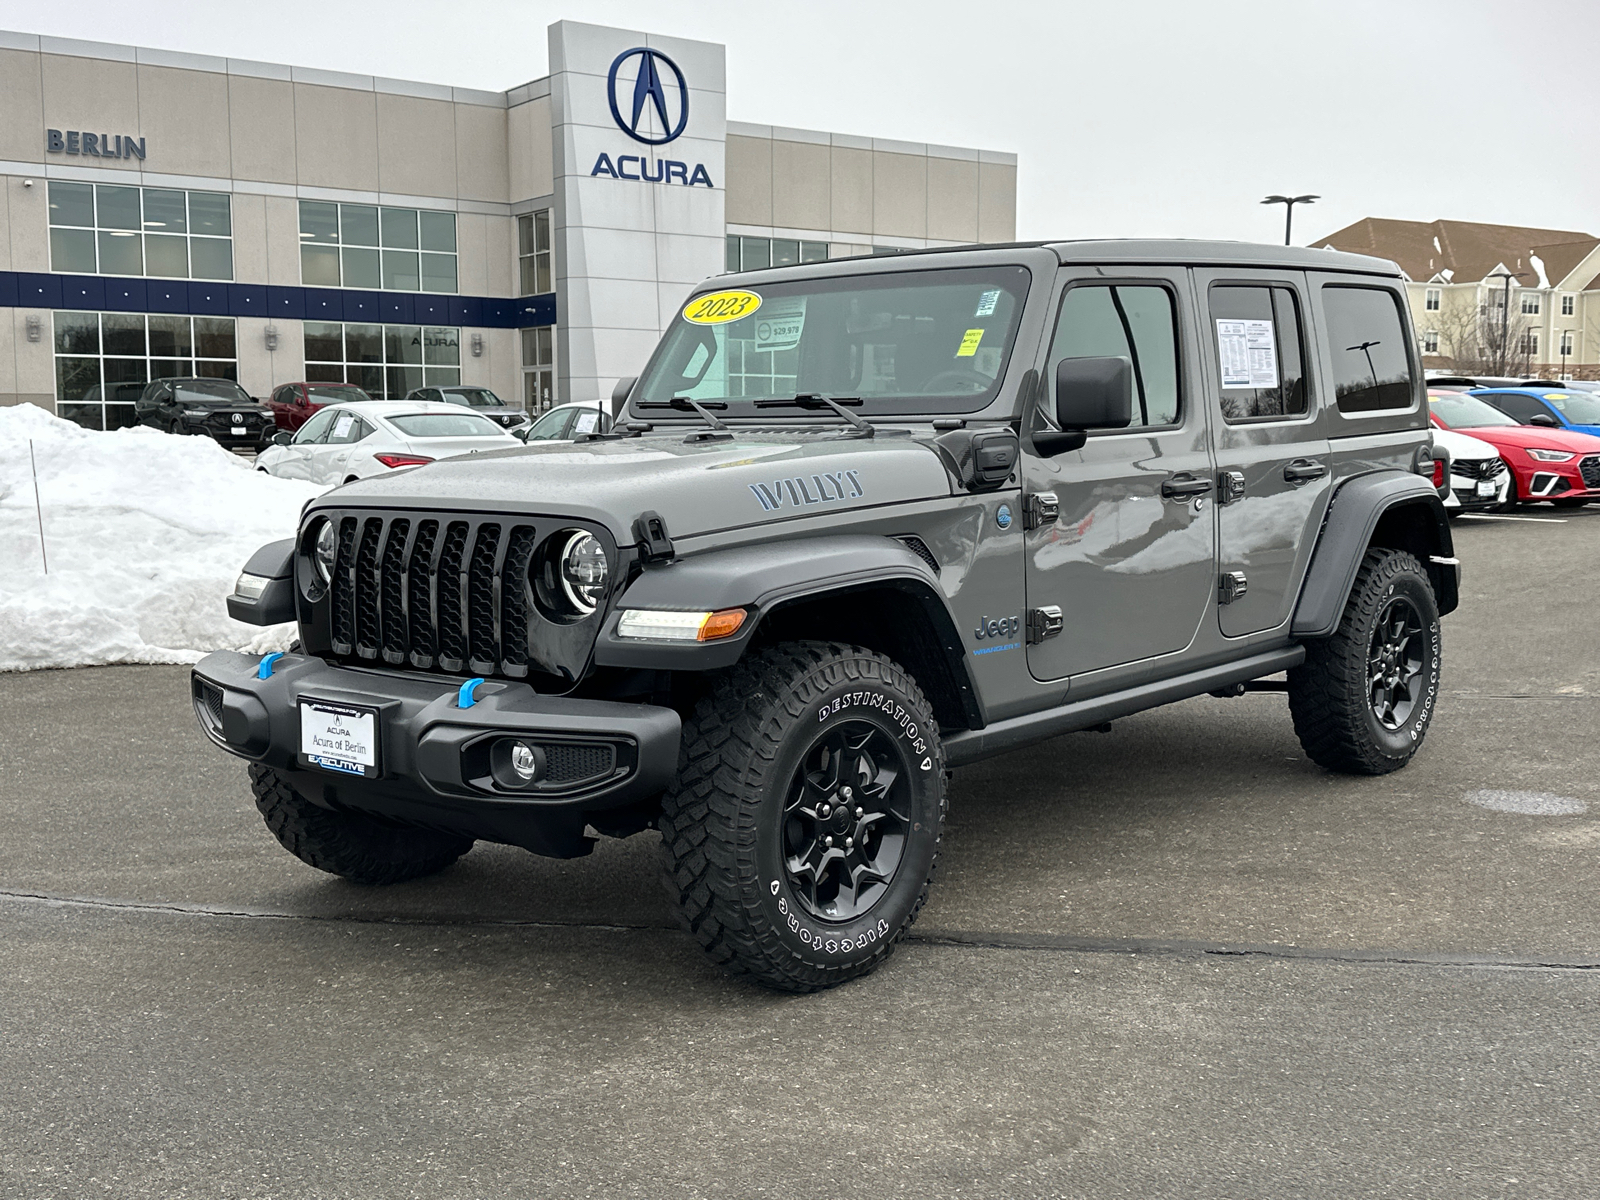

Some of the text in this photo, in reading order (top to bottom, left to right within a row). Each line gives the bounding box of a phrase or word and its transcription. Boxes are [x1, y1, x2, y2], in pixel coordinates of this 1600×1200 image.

[47, 129, 146, 160] BERLIN
[591, 152, 714, 188] ACURA
[692, 296, 752, 319] 2023
[747, 469, 865, 511] WILLYS
[974, 615, 1019, 640] Jeep
[327, 727, 351, 737] ACURA
[818, 691, 927, 755] DESTINATION
[313, 735, 367, 754] Acura of Berlin
[308, 755, 365, 772] EXECUTIVE
